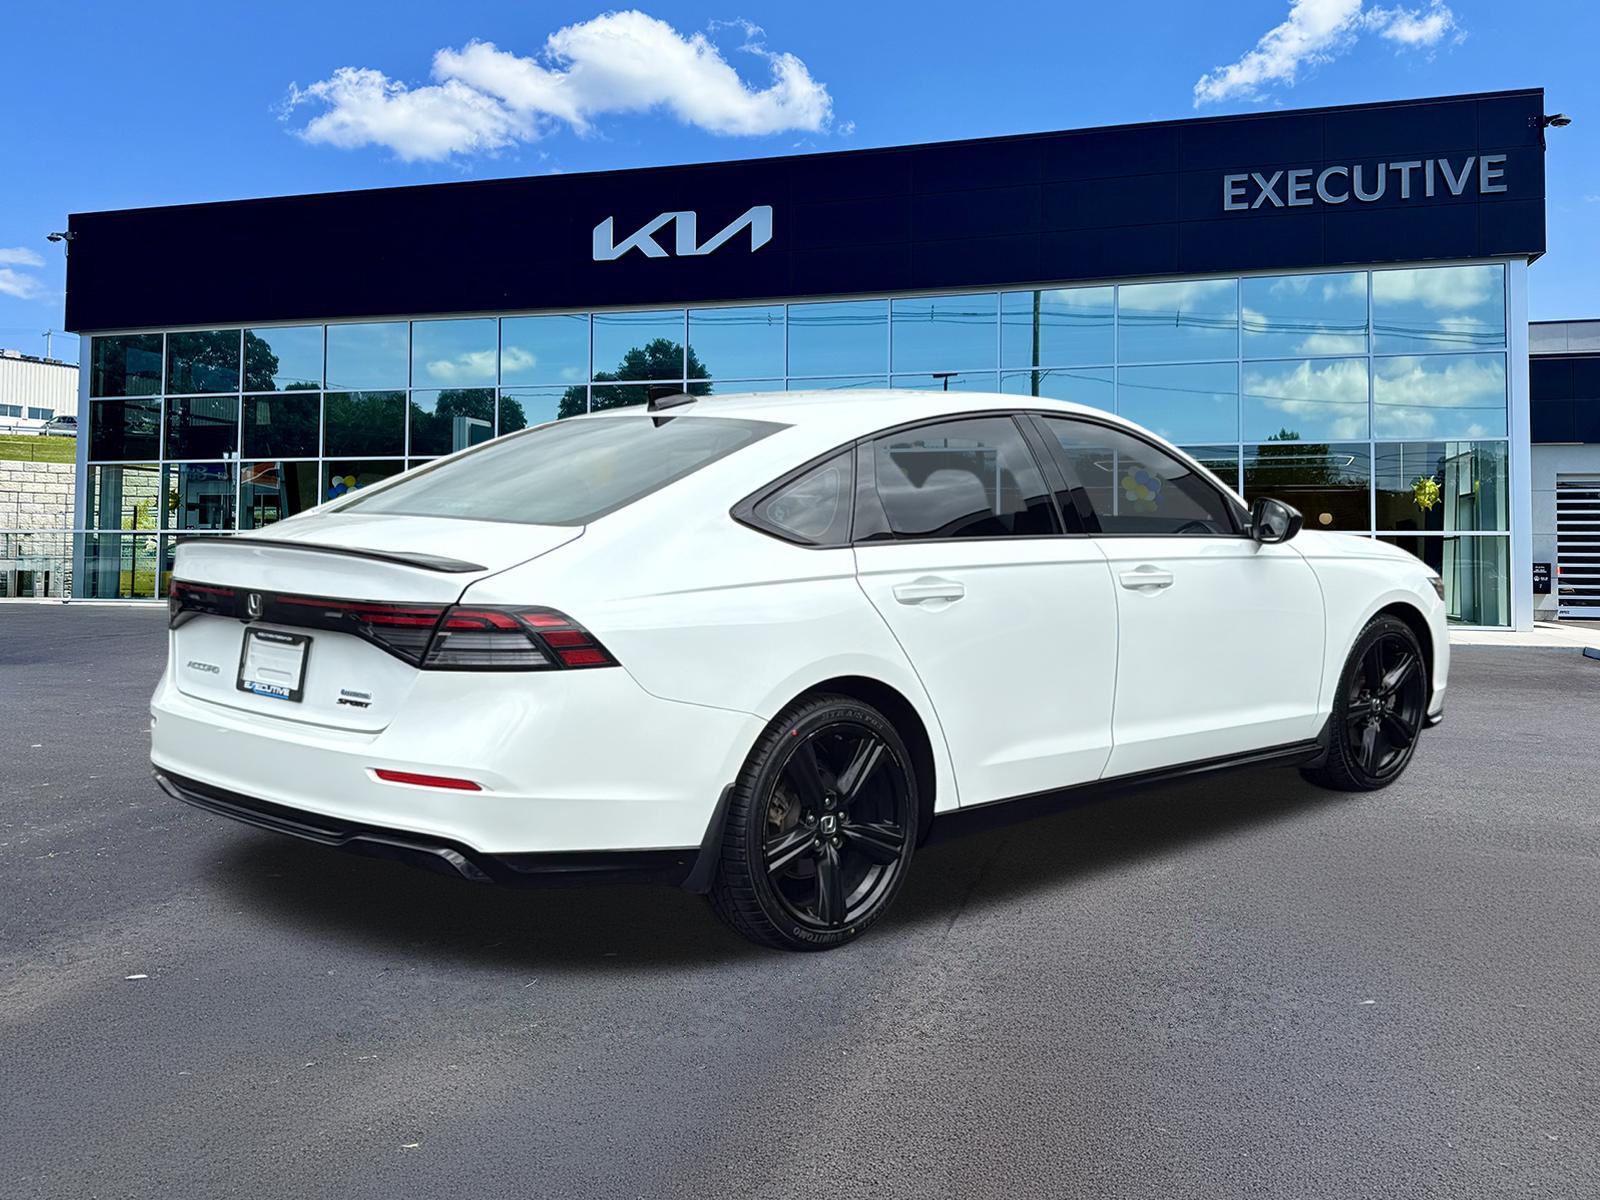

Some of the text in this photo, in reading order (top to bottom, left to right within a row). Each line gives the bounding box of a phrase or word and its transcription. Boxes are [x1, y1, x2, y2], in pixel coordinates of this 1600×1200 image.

[1223, 154, 1508, 211] EXECUTIVE
[592, 205, 773, 261] KIA
[336, 698, 372, 709] SPORT
